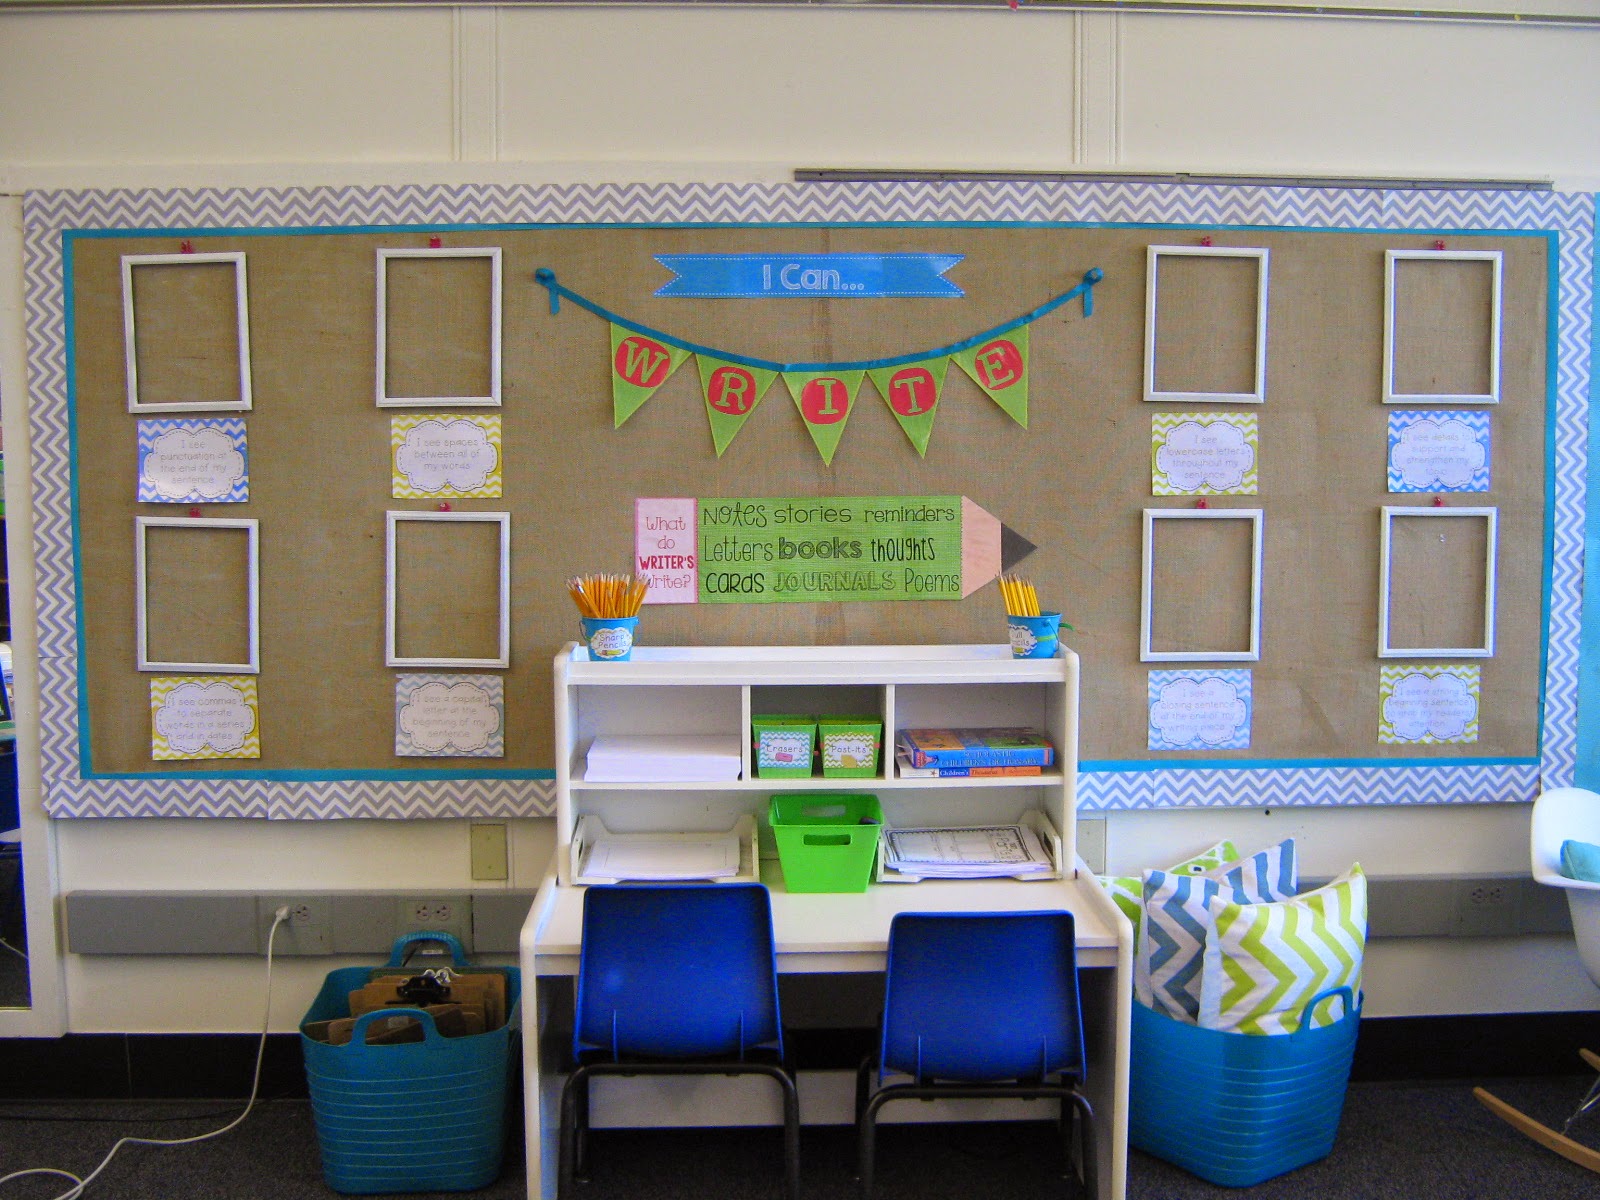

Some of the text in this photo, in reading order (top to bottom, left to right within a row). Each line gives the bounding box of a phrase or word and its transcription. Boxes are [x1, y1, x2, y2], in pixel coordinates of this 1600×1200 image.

[763, 263, 865, 291] I Can...
[190, 441, 206, 449] see
[444, 438, 479, 448] spaces
[1200, 436, 1218, 444] see
[414, 448, 480, 459] between all of
[1167, 446, 1246, 456] lowercase letters
[160, 453, 215, 462] punctuation
[160, 463, 227, 474] the end of my
[424, 462, 471, 472] my words
[1172, 458, 1240, 470] throughout my
[703, 501, 956, 528] Notes stories reminders
[646, 516, 686, 530] What
[658, 535, 676, 550] do
[703, 536, 774, 563] Letters
[778, 536, 863, 560] books
[639, 555, 695, 570] WRITER'S
[772, 571, 897, 593] JOURNALS
[904, 568, 960, 593] Poems
[600, 634, 624, 642] Sharp
[598, 640, 626, 650] Pencils
[178, 698, 196, 706] see
[198, 698, 238, 706] commas
[766, 744, 803, 753] Erasers
[831, 744, 867, 754] Post-its
[940, 768, 969, 778] Children's
